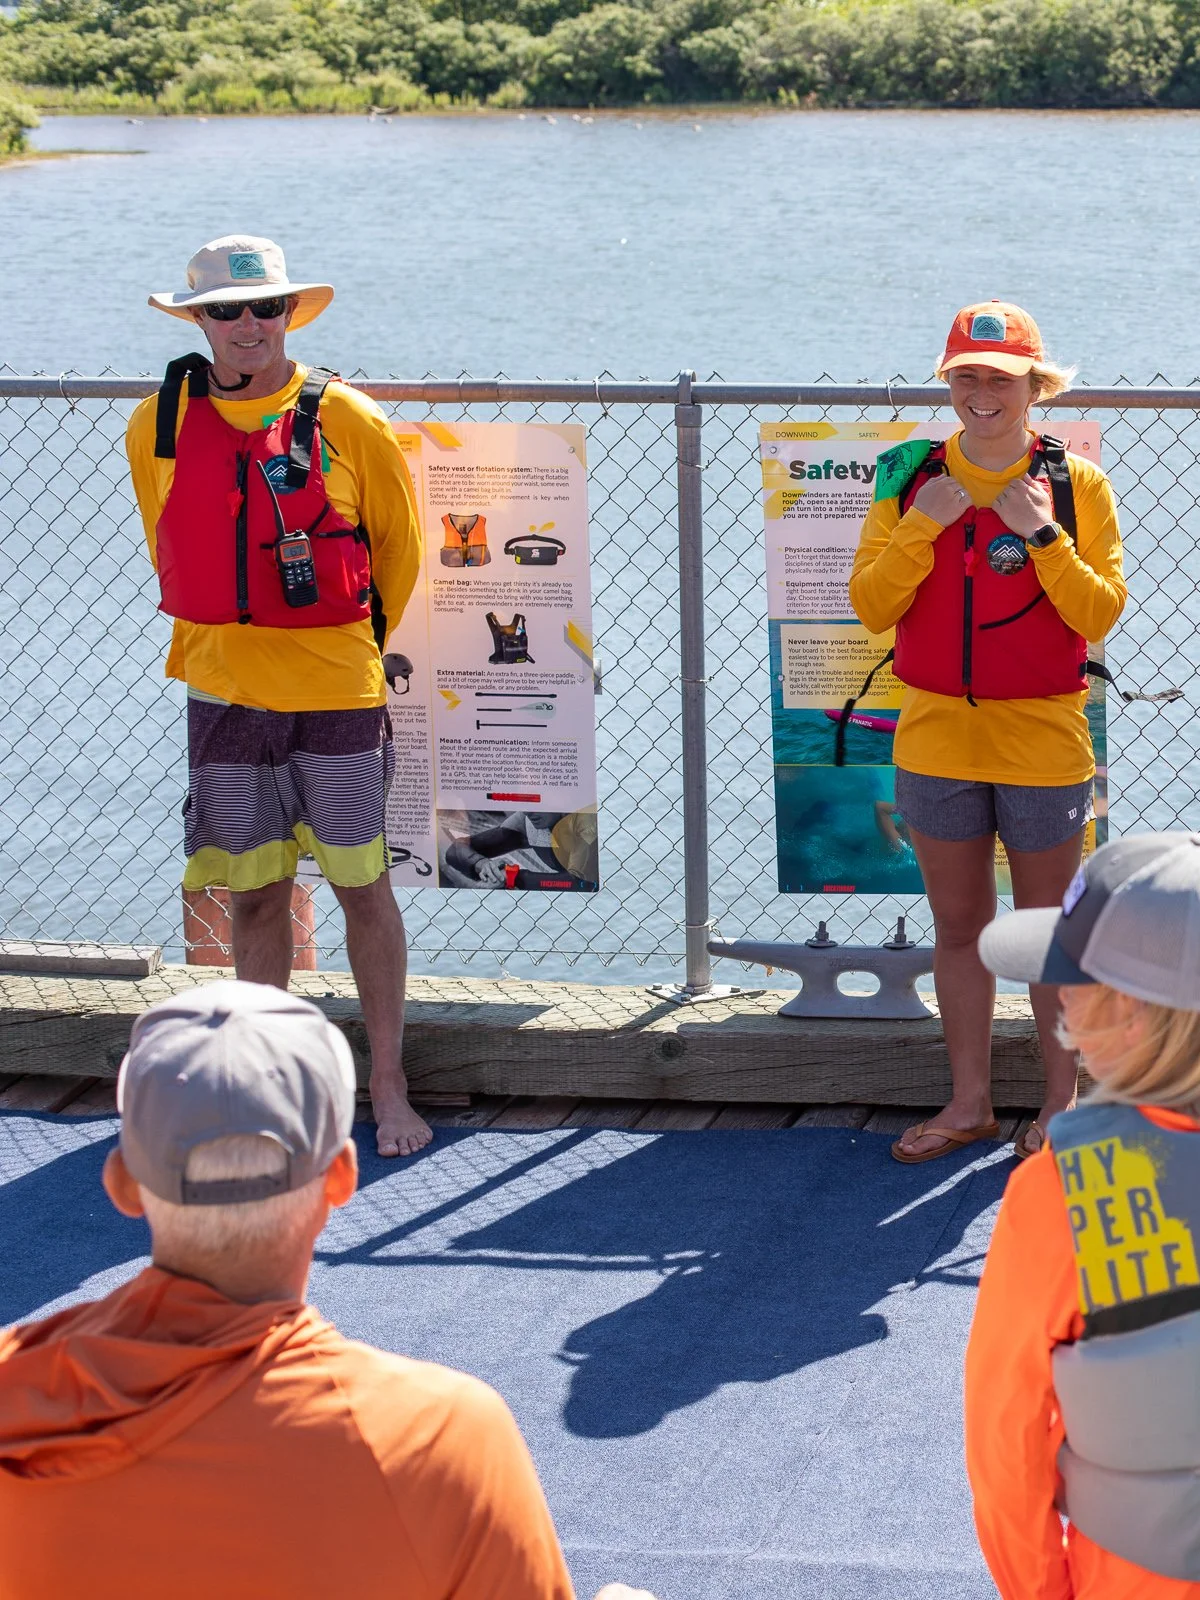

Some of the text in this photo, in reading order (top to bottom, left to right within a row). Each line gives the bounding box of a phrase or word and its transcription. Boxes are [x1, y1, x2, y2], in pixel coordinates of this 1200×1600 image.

[789, 459, 877, 484] Safety
[1060, 1143, 1115, 1195] HY
[1068, 1187, 1159, 1253] PER
